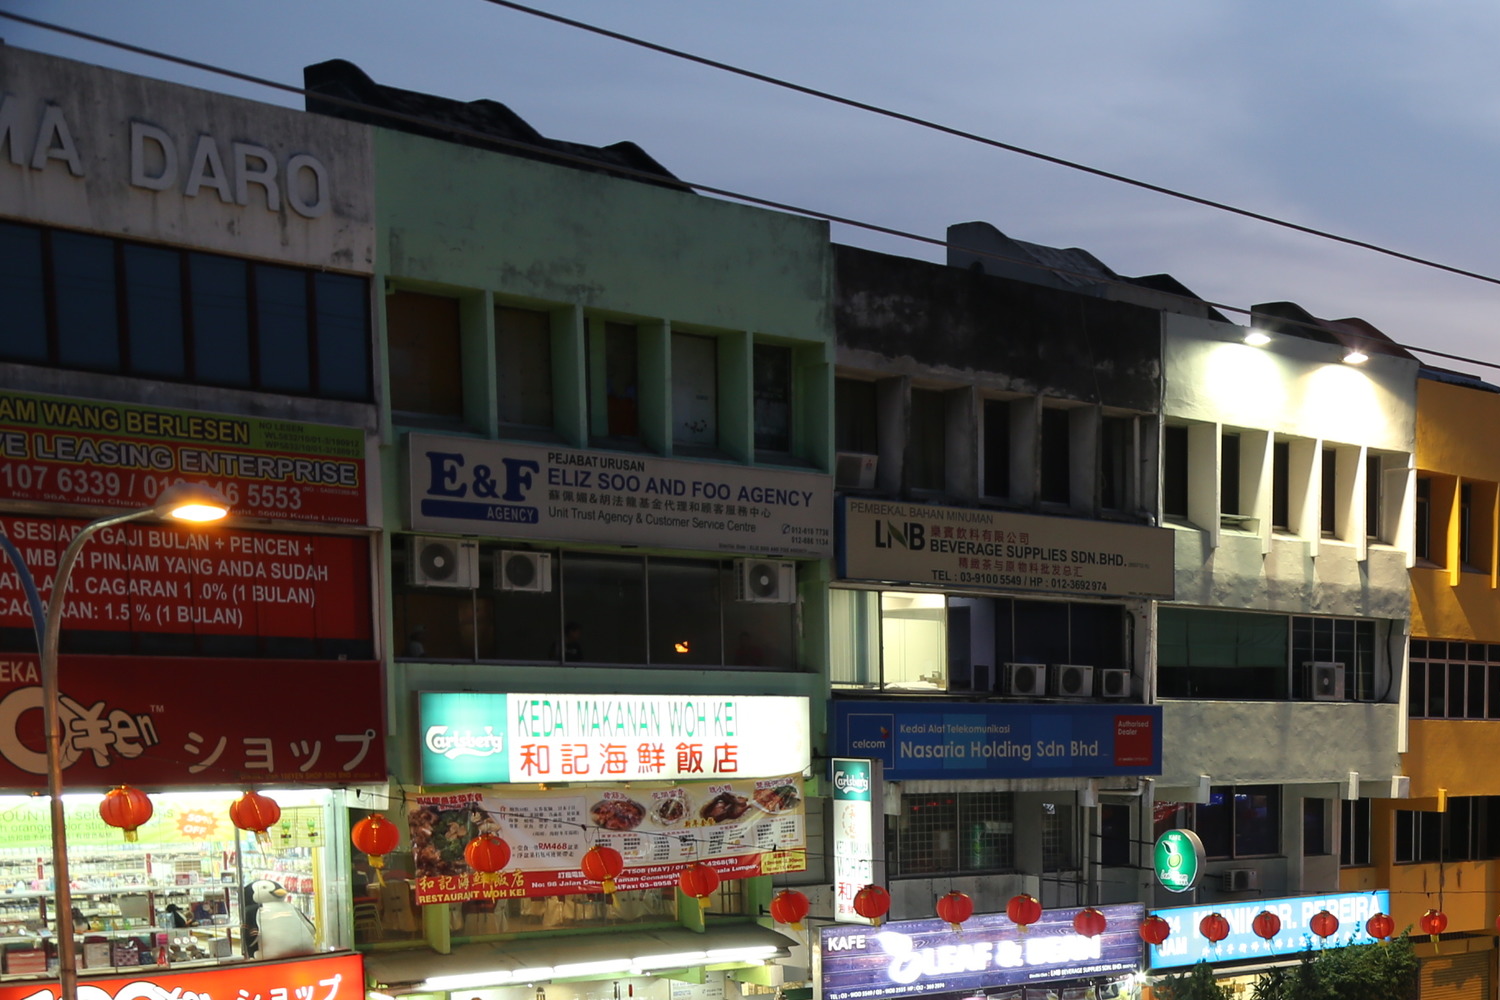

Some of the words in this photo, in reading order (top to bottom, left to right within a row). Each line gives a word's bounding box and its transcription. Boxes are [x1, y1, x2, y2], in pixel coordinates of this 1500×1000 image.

[130, 120, 330, 219] DARO
[43, 402, 120, 431] WANG
[126, 411, 249, 444] BERLESEN
[34, 434, 174, 470] LEASING
[181, 449, 356, 485] ENTERPRISE
[548, 453, 598, 468] PEJABAT
[600, 456, 645, 473] URUSAN
[57, 468, 121, 496] 6339
[248, 484, 301, 510] 5553
[426, 451, 540, 502] E&F
[548, 468, 592, 488] ELIZ
[598, 473, 640, 492] SOO
[646, 477, 686, 496] AND
[692, 481, 731, 500] FOO
[738, 486, 813, 508] AGENCY
[73, 495, 104, 504] Jalan
[290, 512, 319, 521] Kuala
[321, 514, 359, 525] Lumpur
[487, 506, 534, 522] AGENCY
[548, 506, 569, 519] Unit
[571, 507, 596, 521] Trust
[598, 510, 633, 526] Agency
[636, 513, 643, 523] &
[646, 514, 690, 528] Customer
[692, 517, 725, 531] Service
[727, 519, 757, 533] Centre
[850, 502, 906, 517] PEMBEKAL
[909, 507, 944, 519] BAHAN
[946, 511, 993, 524] MINUMAN
[101, 527, 143, 546] GAJI
[149, 530, 208, 550] BULAN
[230, 536, 299, 556] PENCEN
[875, 520, 925, 550] LNB
[930, 539, 1002, 557] BEVERAGE
[1007, 545, 1067, 562] SUPPLIES
[90, 552, 159, 572] PINJAM
[164, 555, 213, 576] YANG
[217, 559, 267, 578] ANDA
[271, 563, 328, 581] SUDAH
[931, 570, 951, 581] TEL
[86, 577, 177, 598] CAGARAN
[252, 585, 315, 608] BULAN)
[105, 603, 130, 620] 1.5
[178, 605, 243, 629] BULAN)
[517, 700, 569, 738] KEDAI
[578, 701, 660, 738] MAKANAN
[668, 701, 706, 737] WOH
[713, 702, 738, 737] KEI
[900, 724, 926, 734] Kedai
[928, 724, 945, 733] Alat
[947, 724, 1010, 734] Telekomunikasi
[1118, 720, 1149, 728] Authorised
[1118, 728, 1137, 736] Dealer
[184, 728, 376, 774] ショップ
[425, 725, 503, 760] Carlsberg
[852, 739, 886, 749] celcom
[900, 741, 965, 758] Nasaria
[971, 741, 1031, 761] Holding
[1036, 740, 1065, 757] Sdn
[1070, 740, 1098, 756] Bhd
[520, 742, 739, 777] 和記海鮮飯店
[835, 771, 869, 792] Carlsberg
[418, 891, 479, 904] RESTAURANT
[510, 889, 526, 898] KEI
[828, 935, 866, 951] KAFE
[1158, 936, 1188, 957] JAM
